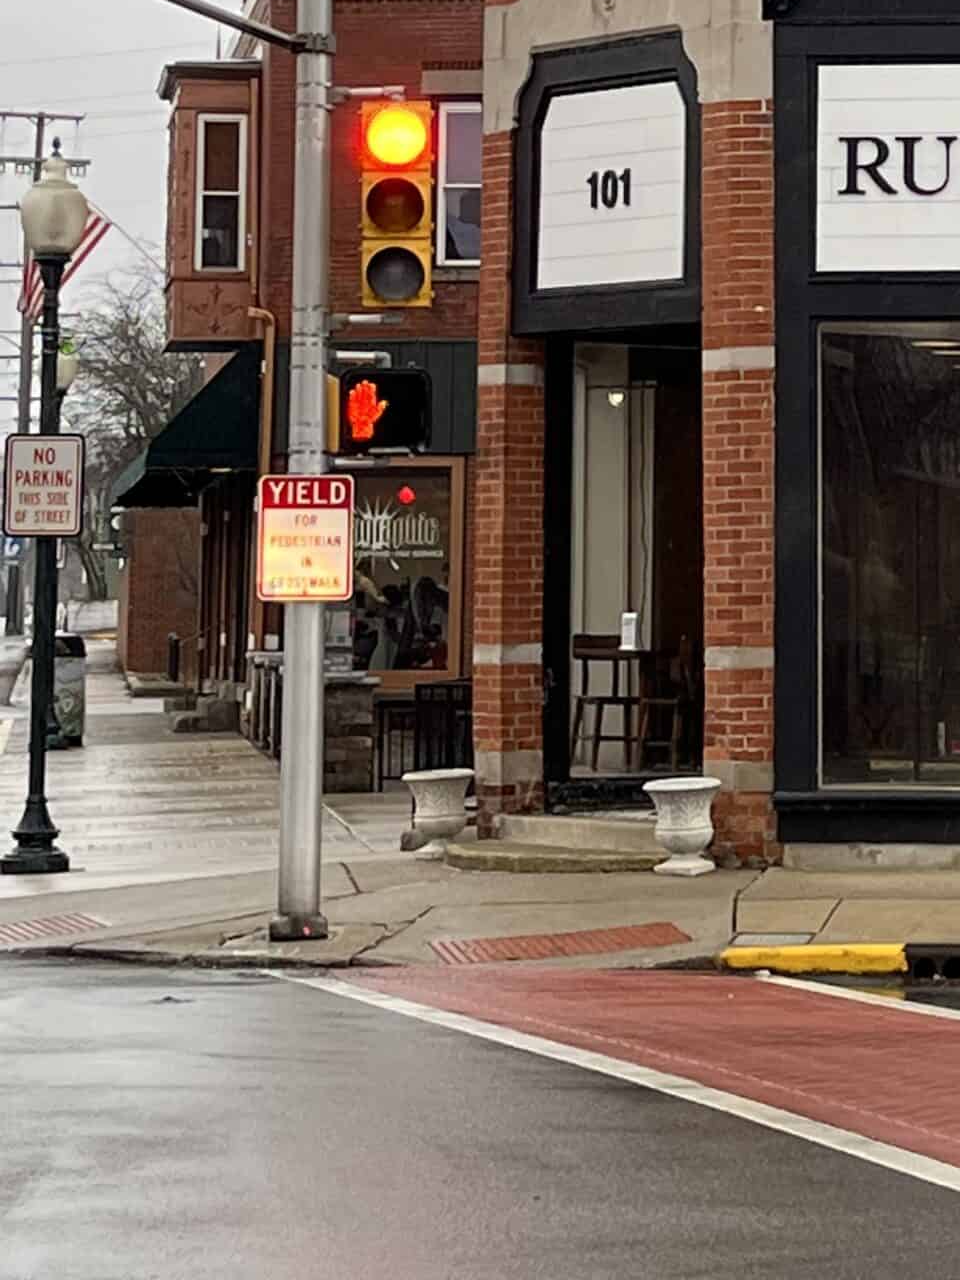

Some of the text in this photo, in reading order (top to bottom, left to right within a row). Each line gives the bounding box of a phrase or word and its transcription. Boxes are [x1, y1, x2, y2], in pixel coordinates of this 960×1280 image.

[586, 167, 632, 210] 101
[33, 447, 56, 465] NO
[15, 470, 73, 487] PARKING
[19, 492, 69, 506] THIS SIDE
[268, 480, 347, 505] YIELD
[15, 510, 71, 524] OF STREET
[294, 514, 318, 528] FOR
